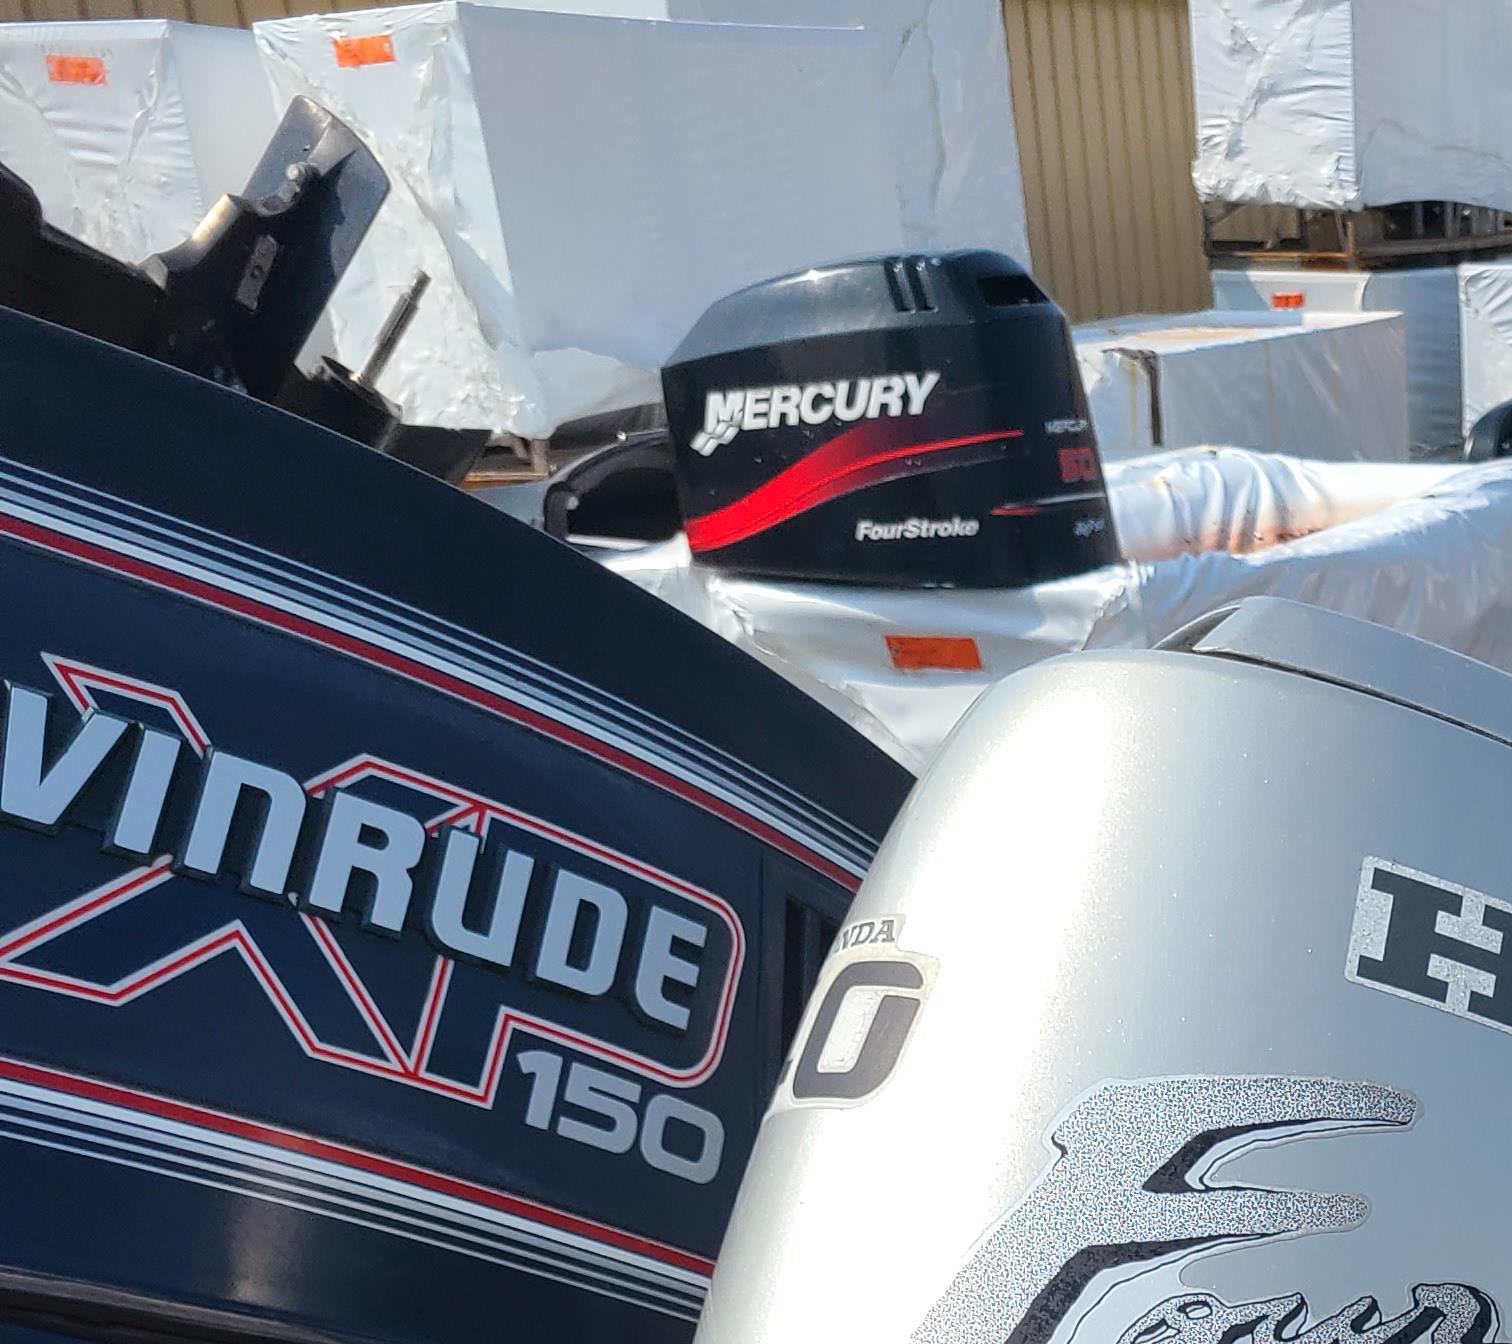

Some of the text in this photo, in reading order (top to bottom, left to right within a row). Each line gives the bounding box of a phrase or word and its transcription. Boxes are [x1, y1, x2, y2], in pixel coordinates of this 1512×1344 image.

[697, 372, 940, 447] MERCURY
[855, 516, 980, 541] FourStroke
[516, 1049, 726, 1184] 150
